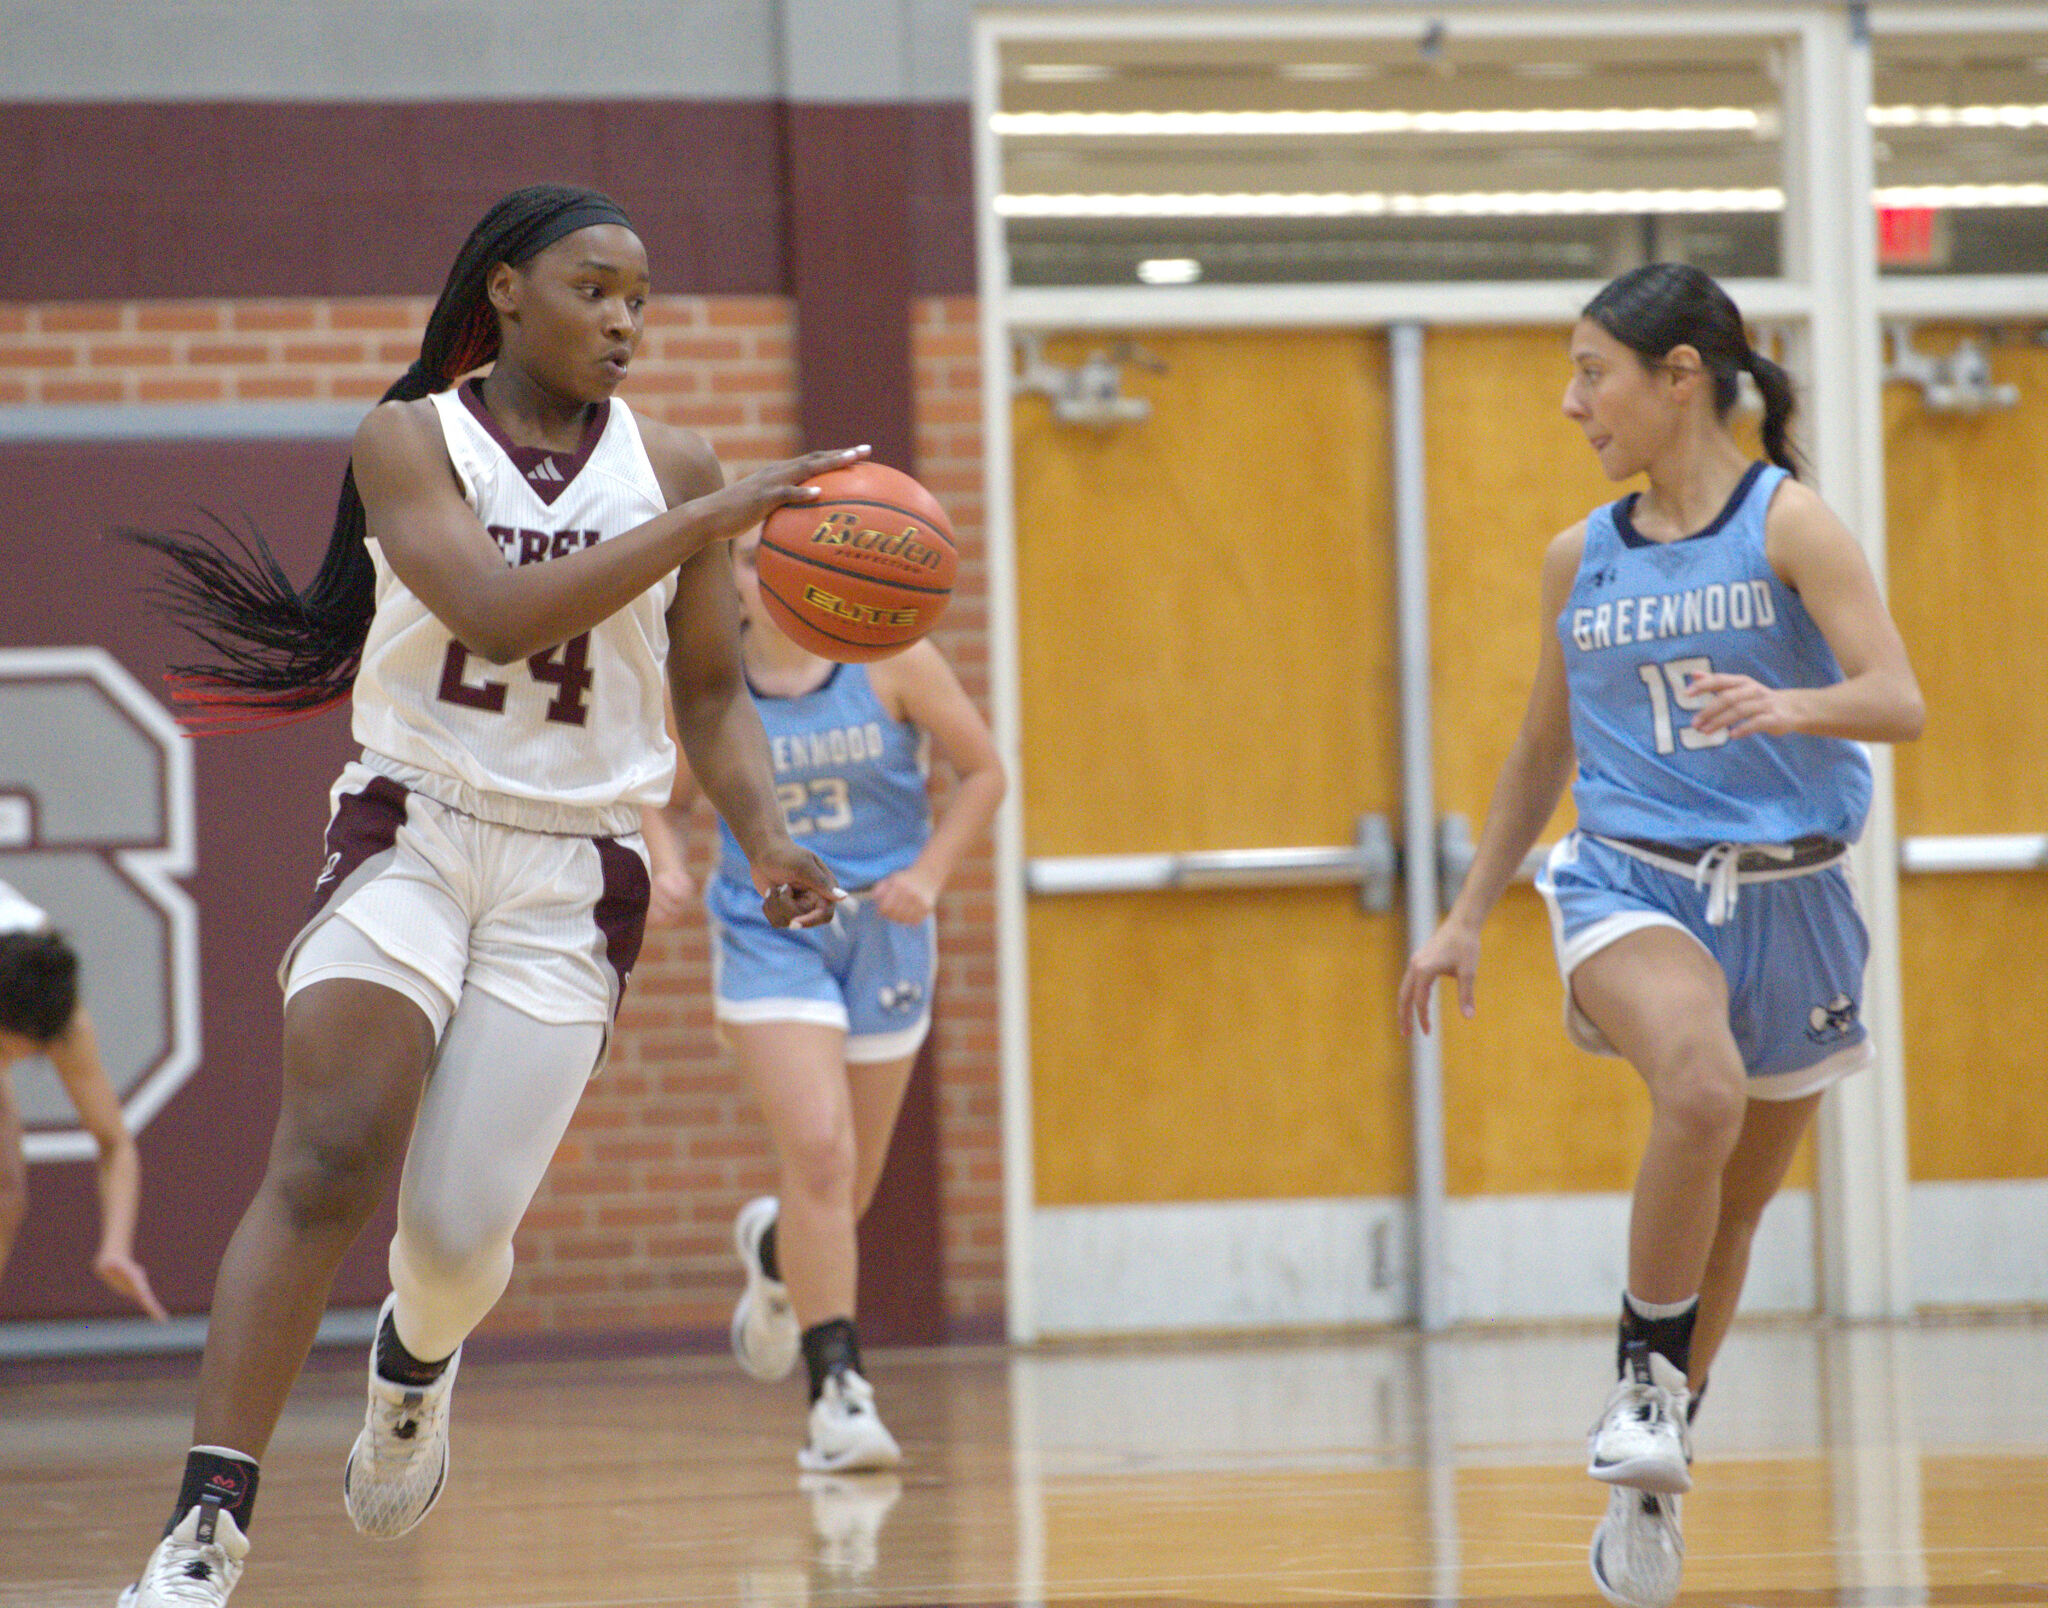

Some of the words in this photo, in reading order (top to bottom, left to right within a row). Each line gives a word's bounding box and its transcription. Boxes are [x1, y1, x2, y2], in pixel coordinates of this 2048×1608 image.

[811, 512, 942, 570] Baden
[803, 583, 919, 626] ELITE
[1572, 578, 1777, 652] GREENWOOD
[1637, 655, 1731, 755] 15
[776, 777, 853, 835] 23
